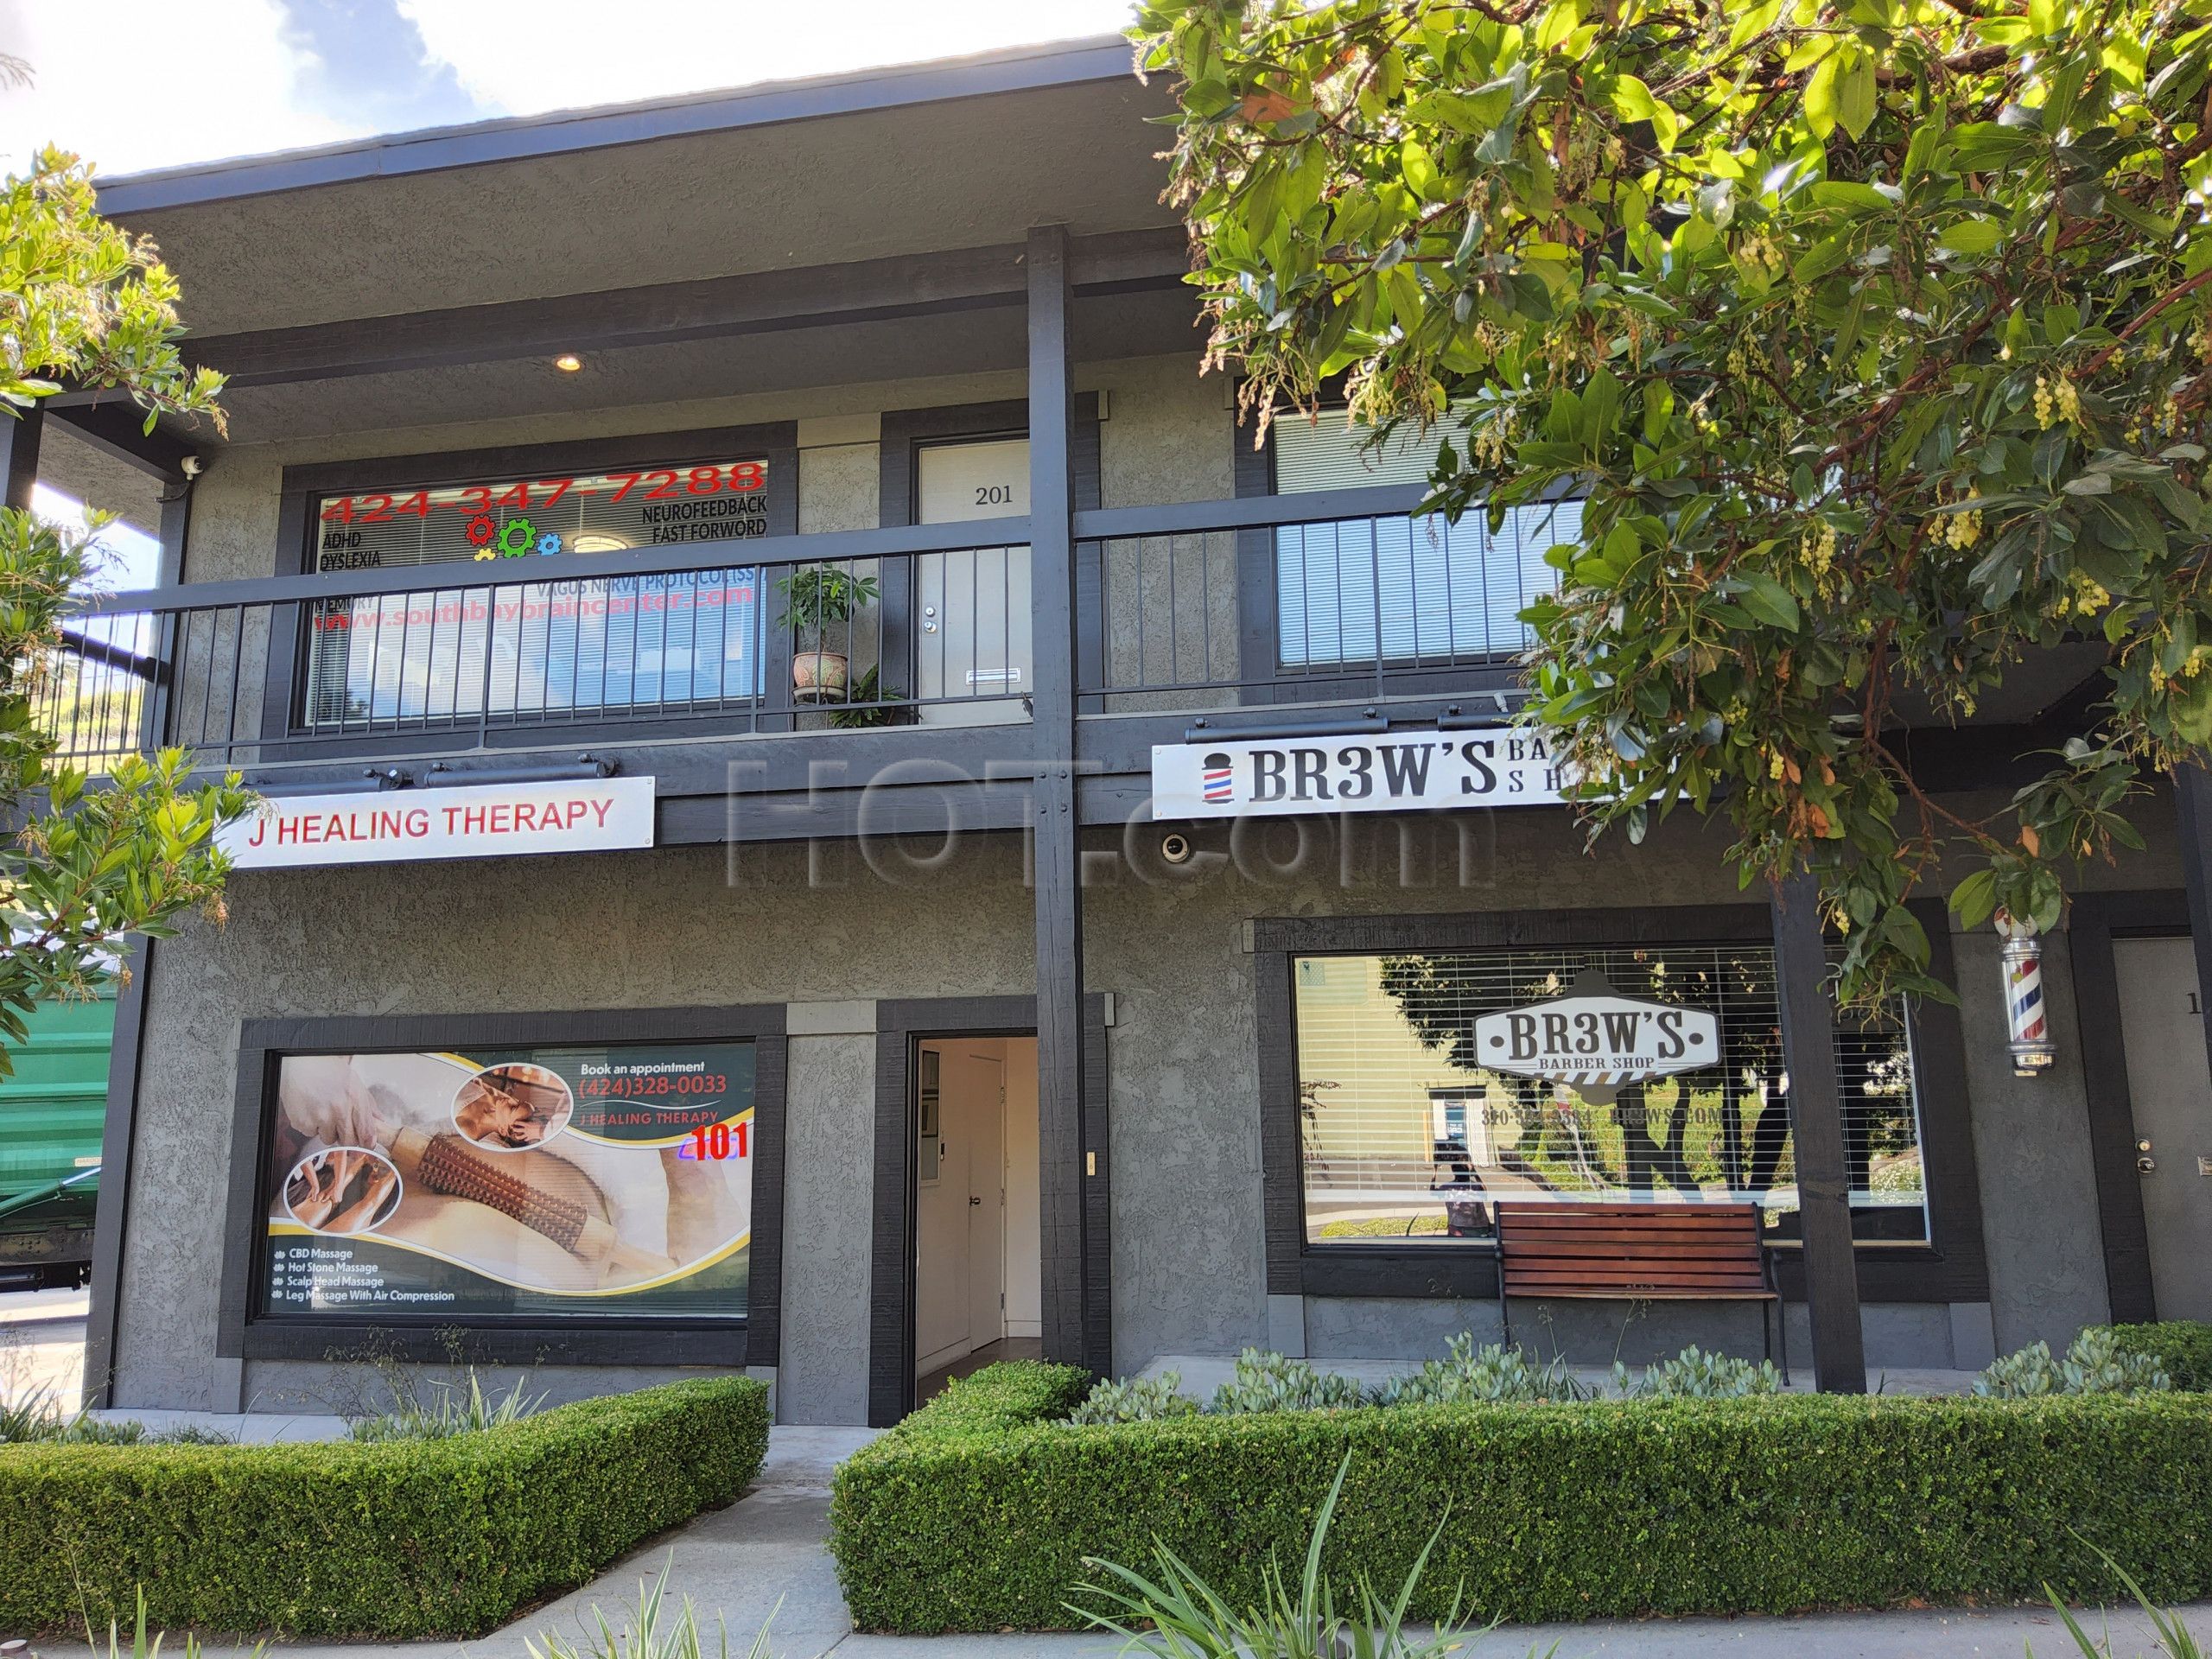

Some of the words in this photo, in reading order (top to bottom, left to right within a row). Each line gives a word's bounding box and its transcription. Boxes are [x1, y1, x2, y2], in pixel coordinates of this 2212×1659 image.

[321, 462, 765, 524] 424-347-7288
[976, 486, 1013, 505] 201
[642, 496, 767, 524] NEUROFEEDBACK
[322, 531, 362, 550] ADHD
[652, 524, 688, 543] FAST
[691, 518, 767, 541] FORWORD
[320, 550, 381, 571] DYSLEXIA
[1249, 740, 1494, 804] BR3W'S
[249, 818, 265, 848] J
[278, 809, 430, 846] HEALING
[442, 798, 614, 836] THERAPY
[1506, 1011, 1685, 1060] BR3W'S
[581, 1063, 611, 1076] Book
[614, 1065, 628, 1075] an
[630, 1061, 705, 1077] appointment
[1539, 1058, 1605, 1070] BARBER
[1613, 1057, 1654, 1069] SHOP
[578, 1075, 727, 1099] (424)328-0033
[580, 1115, 586, 1125] J
[590, 1112, 652, 1125] HEALING
[656, 1111, 719, 1123] THERAPY
[691, 1122, 747, 1161] 101
[289, 1248, 309, 1259] CBD
[310, 1249, 353, 1260] Massage
[288, 1262, 306, 1272] Hot
[307, 1262, 334, 1272] Stone
[336, 1263, 378, 1274] Massage
[287, 1276, 312, 1289] Scalp
[314, 1276, 340, 1287] Head
[341, 1276, 385, 1287] Massage
[286, 1290, 304, 1302] Leg
[307, 1289, 348, 1302] Massage
[349, 1290, 372, 1301] With
[373, 1290, 389, 1301] Air
[390, 1290, 455, 1302] Compression
